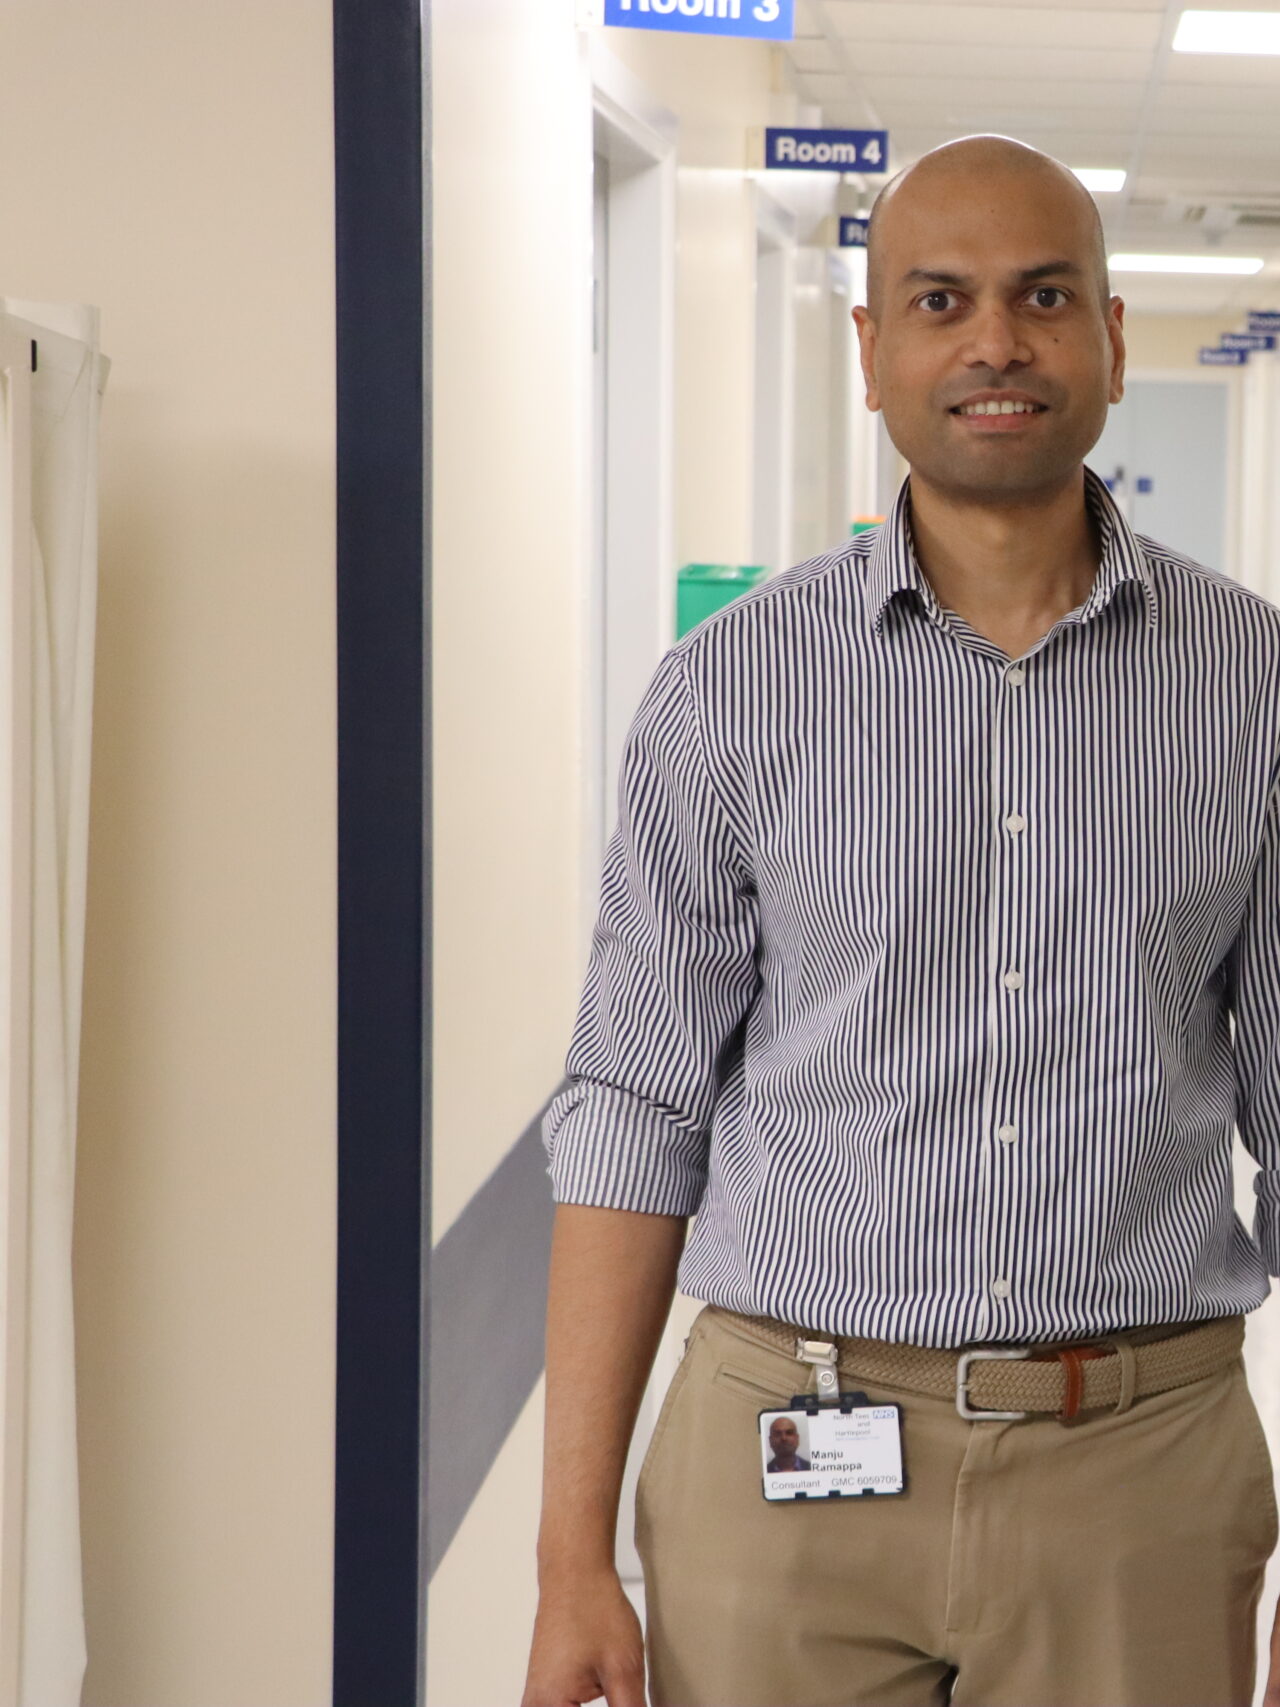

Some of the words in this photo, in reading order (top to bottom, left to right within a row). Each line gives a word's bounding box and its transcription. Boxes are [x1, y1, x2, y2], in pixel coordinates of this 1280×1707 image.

[776, 136, 856, 164] Room
[861, 138, 882, 165] 4
[873, 1409, 896, 1419] NHS
[811, 1449, 844, 1461] Manju
[812, 1462, 863, 1473] Ramappa
[771, 1480, 821, 1490] Consultant
[831, 1477, 855, 1487] GMC
